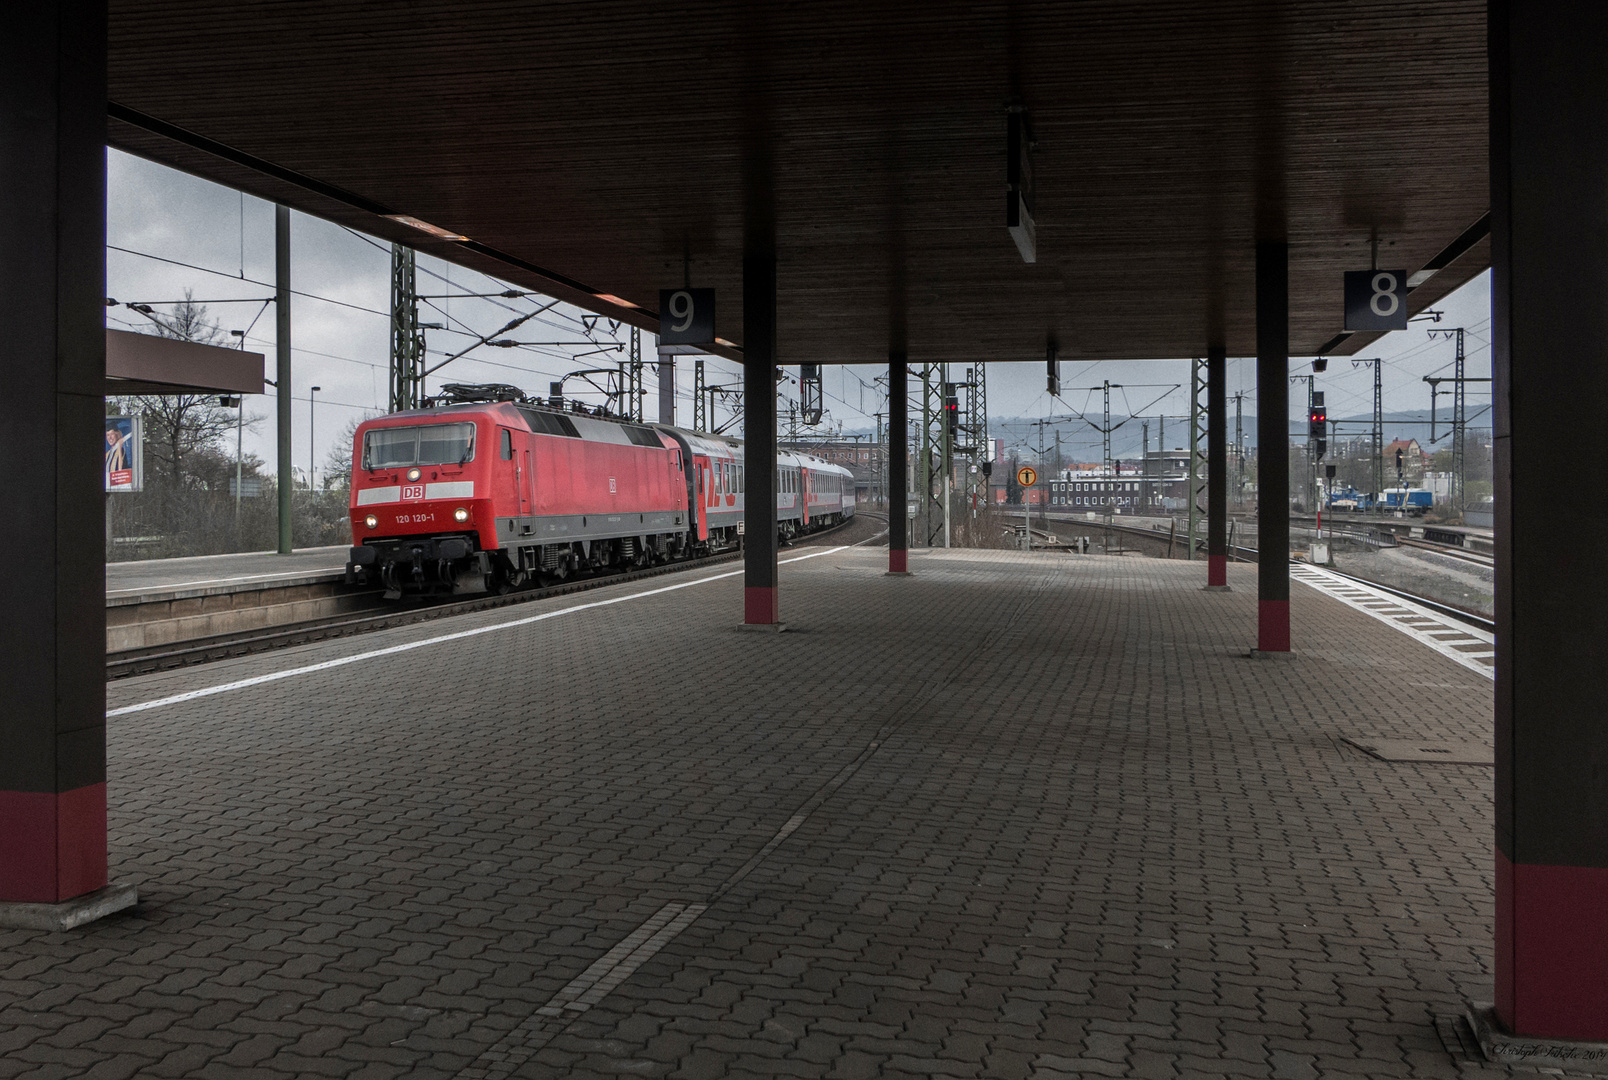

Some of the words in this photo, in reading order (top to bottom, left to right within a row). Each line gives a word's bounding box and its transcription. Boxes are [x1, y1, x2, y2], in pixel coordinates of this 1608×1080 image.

[1370, 272, 1399, 317] 8
[668, 290, 695, 332] 9
[404, 487, 422, 498] DB
[395, 515, 410, 524] 120
[412, 513, 435, 523] 120-1
